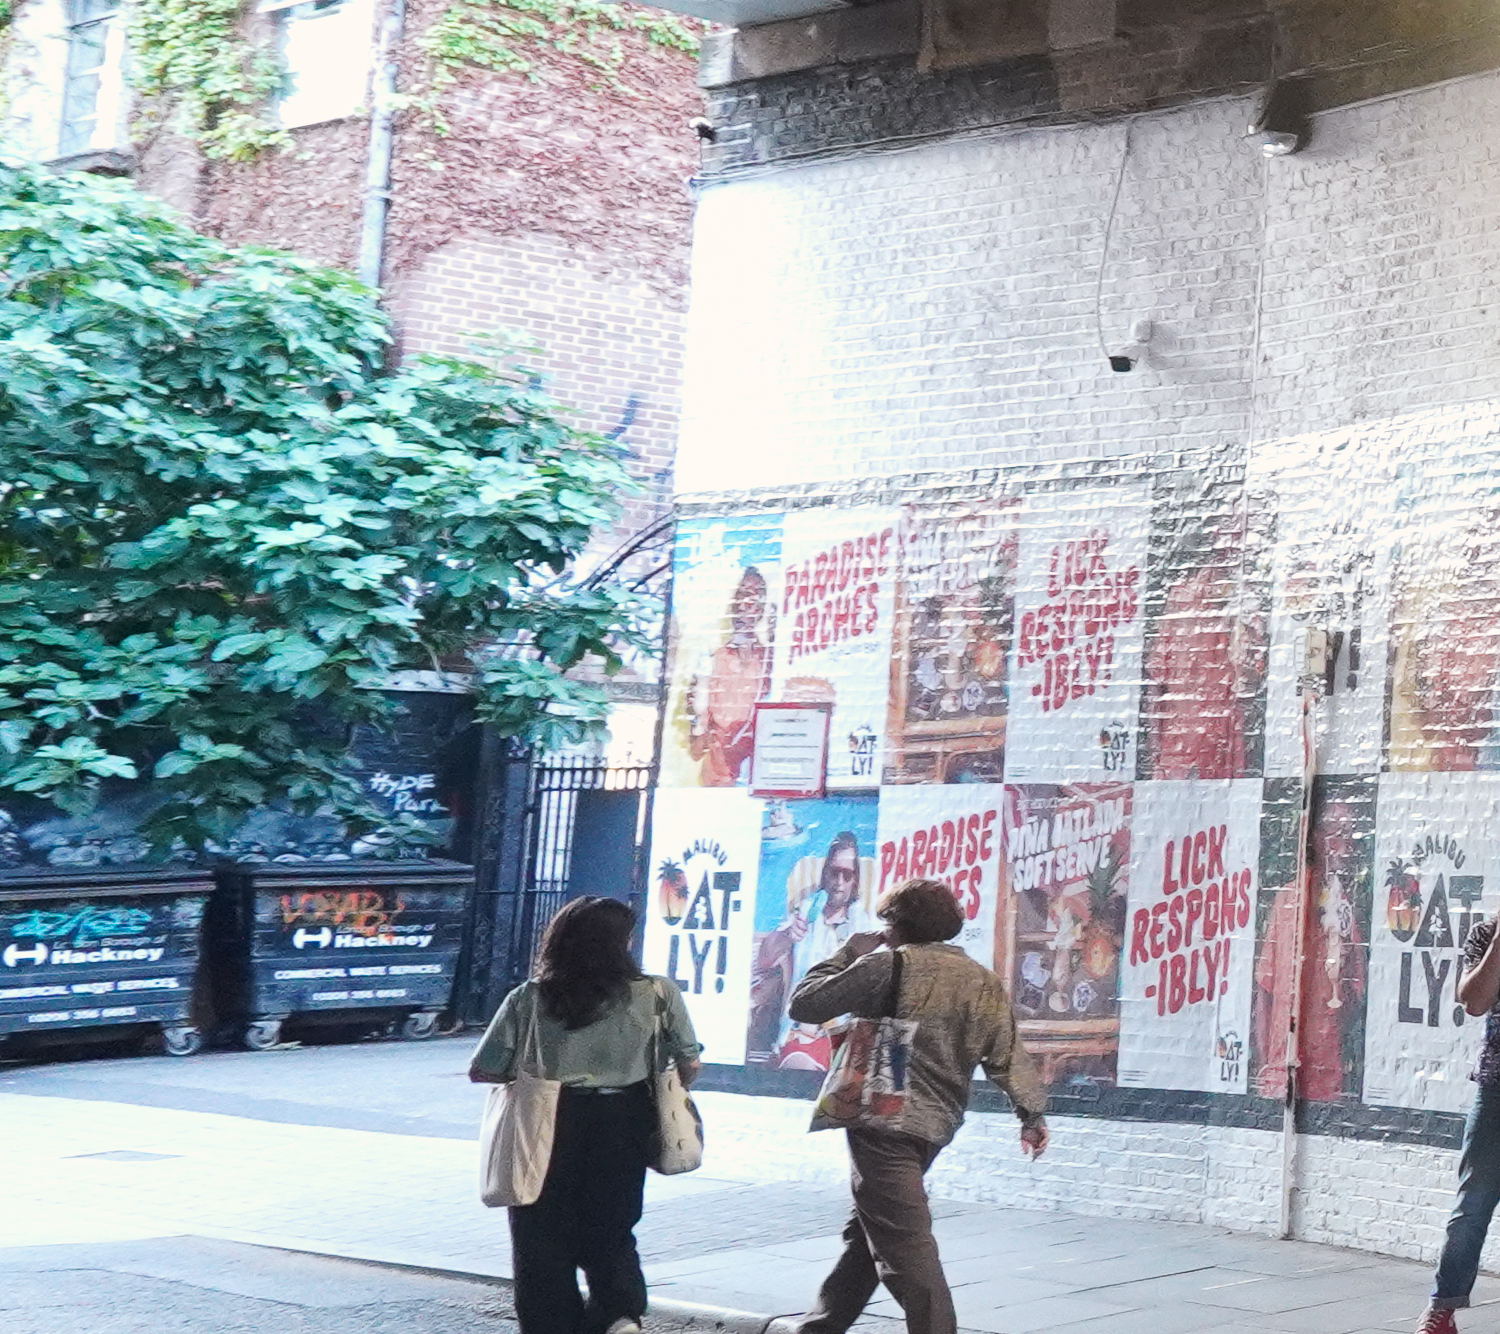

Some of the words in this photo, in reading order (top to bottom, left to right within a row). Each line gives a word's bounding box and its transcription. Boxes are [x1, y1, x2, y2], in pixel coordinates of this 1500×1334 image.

[783, 527, 894, 618] PARADISE
[788, 582, 880, 665] ARCHES
[682, 838, 728, 867] MALIBU
[878, 809, 997, 894] PARADISE
[1012, 851, 1057, 893] SOFT
[1056, 835, 1113, 882] SERVE
[1163, 824, 1227, 896] LICK
[1412, 833, 1466, 870] MALIBU
[334, 933, 434, 948] Hackney
[1130, 868, 1251, 967] RESPONS
[51, 948, 165, 965] Hackney
[667, 933, 728, 995] LY!
[1145, 938, 1231, 1017] -IBLY!
